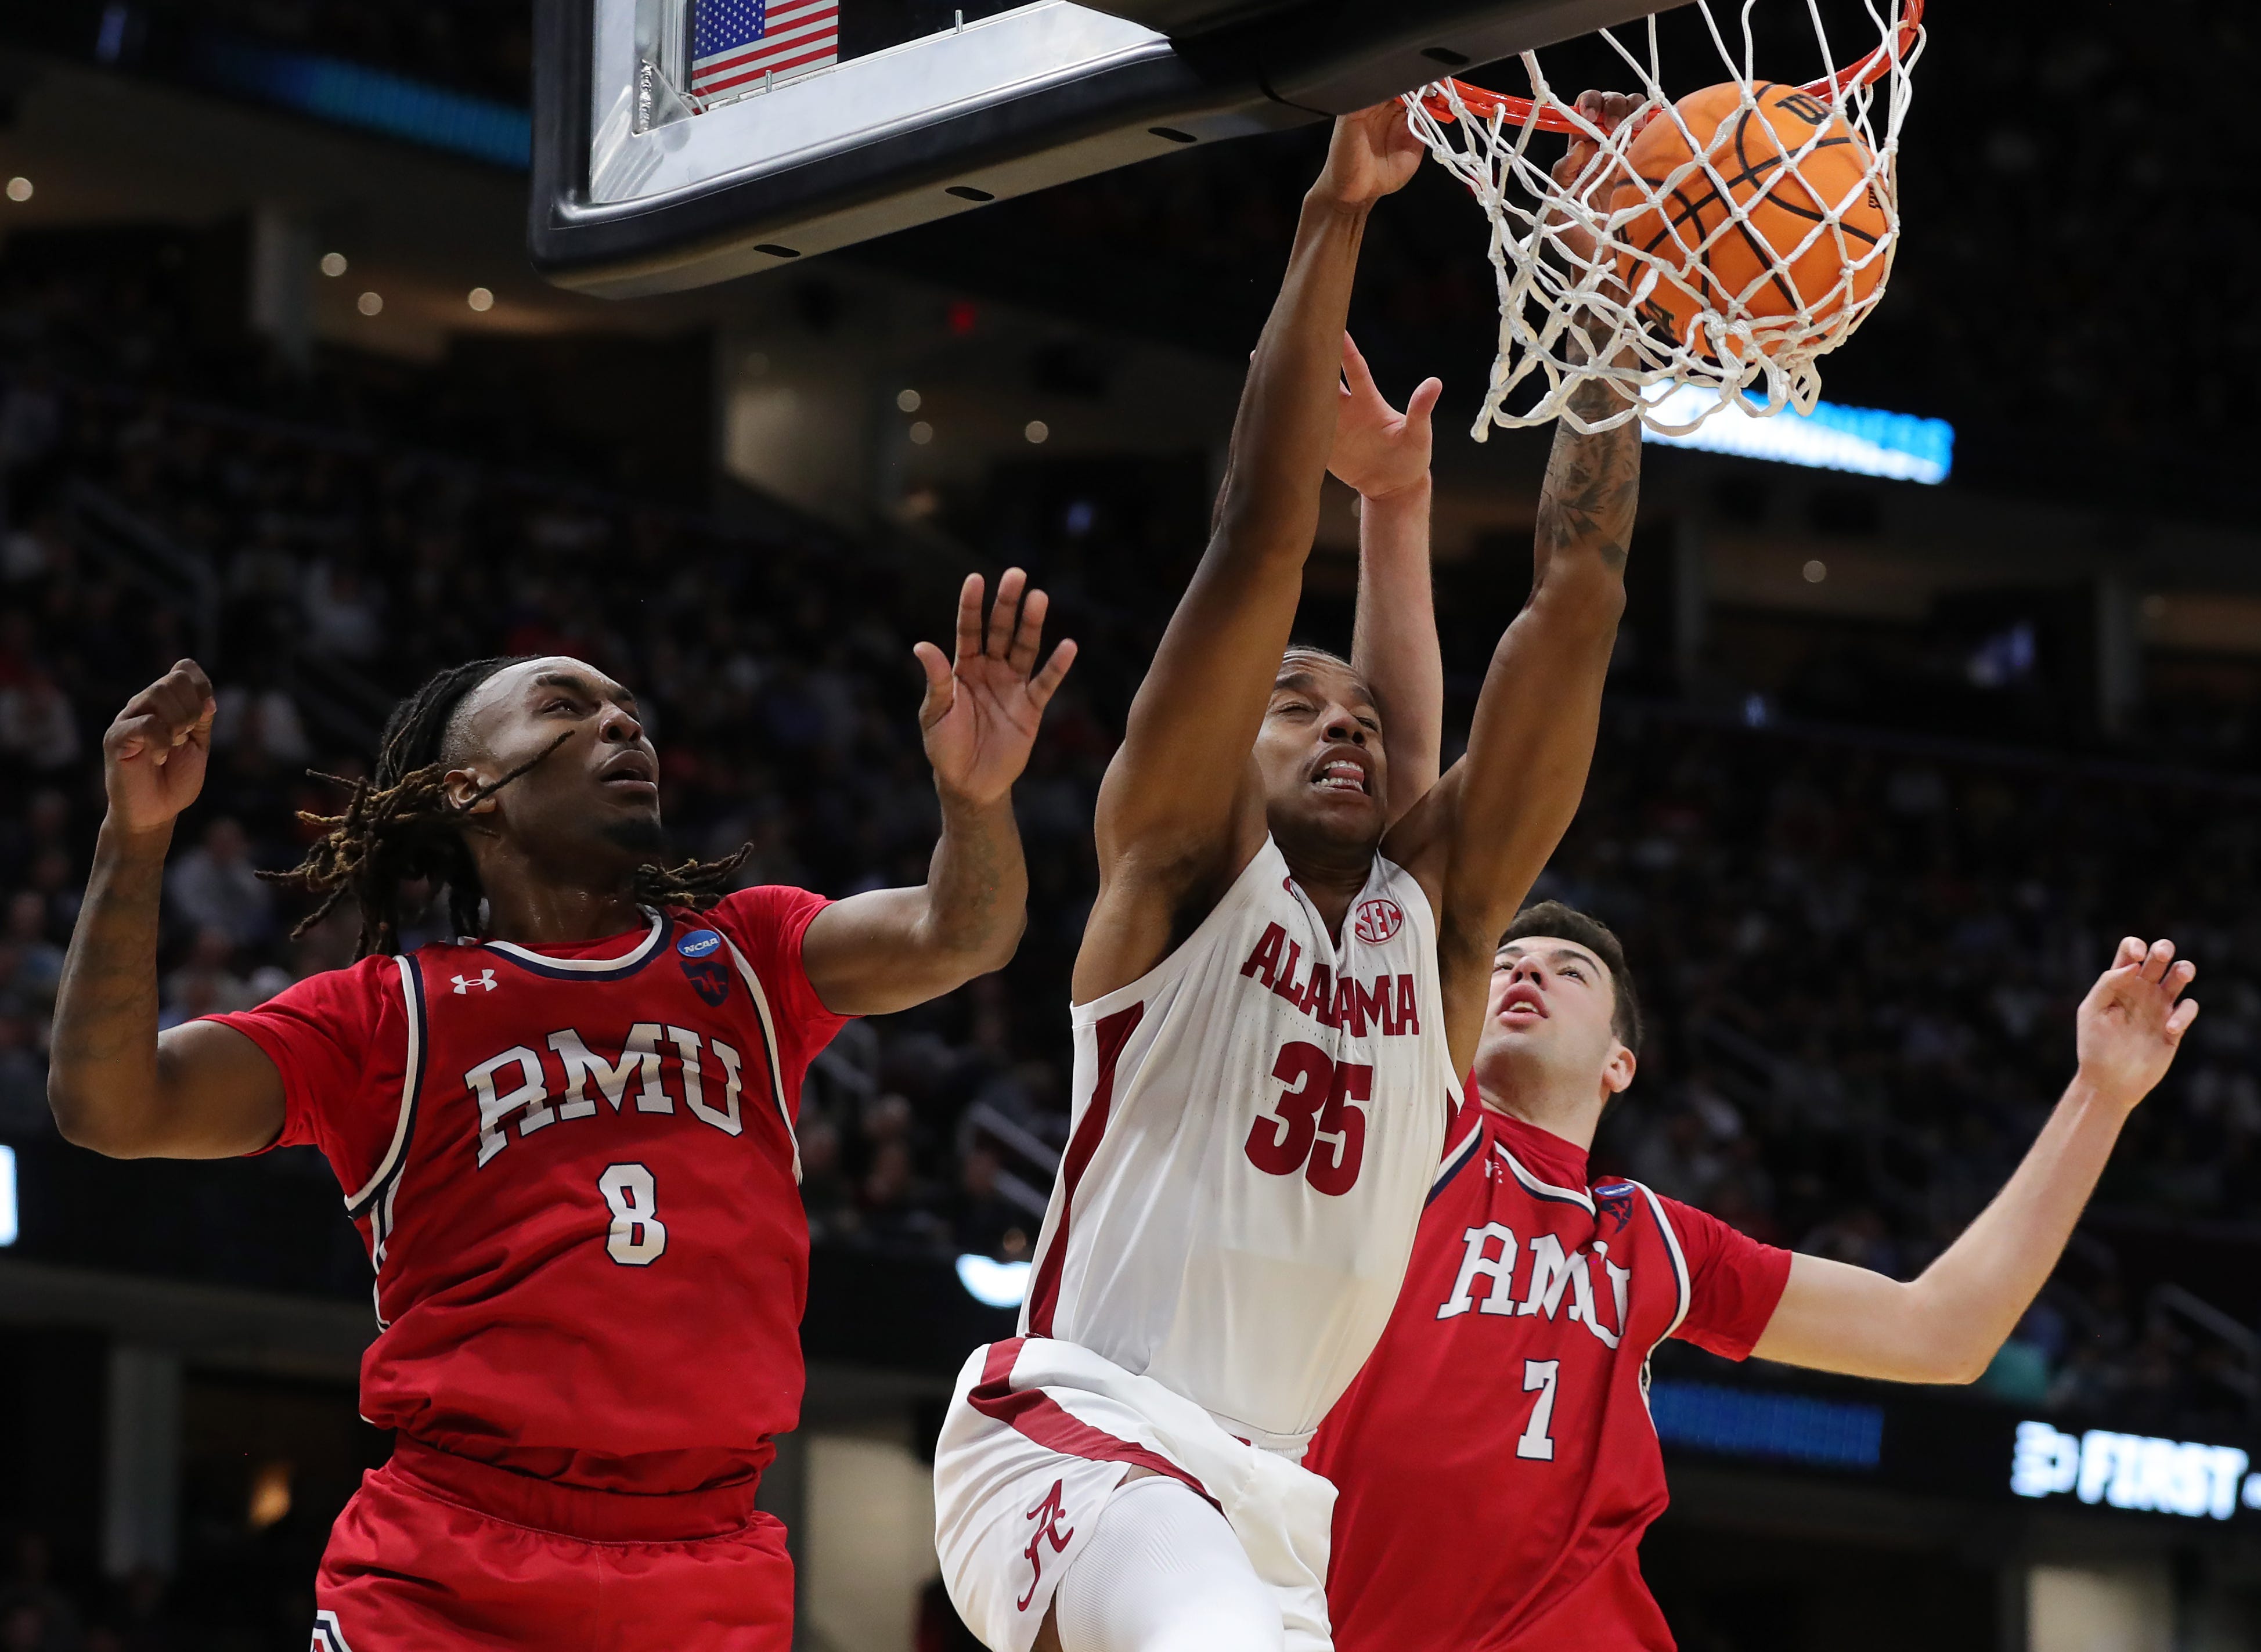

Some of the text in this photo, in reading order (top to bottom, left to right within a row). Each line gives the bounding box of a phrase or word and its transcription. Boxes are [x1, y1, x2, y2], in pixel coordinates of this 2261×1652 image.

[683, 937, 719, 954] NCAA
[1355, 901, 1400, 940] SEC
[1241, 921, 1419, 1038] ALAAMA
[464, 1022, 744, 1170] RMU
[1244, 1041, 1373, 1196] 35
[597, 1162, 668, 1268] 8
[1436, 1221, 1631, 1350] RMU
[1516, 1358, 1560, 1462] 7
